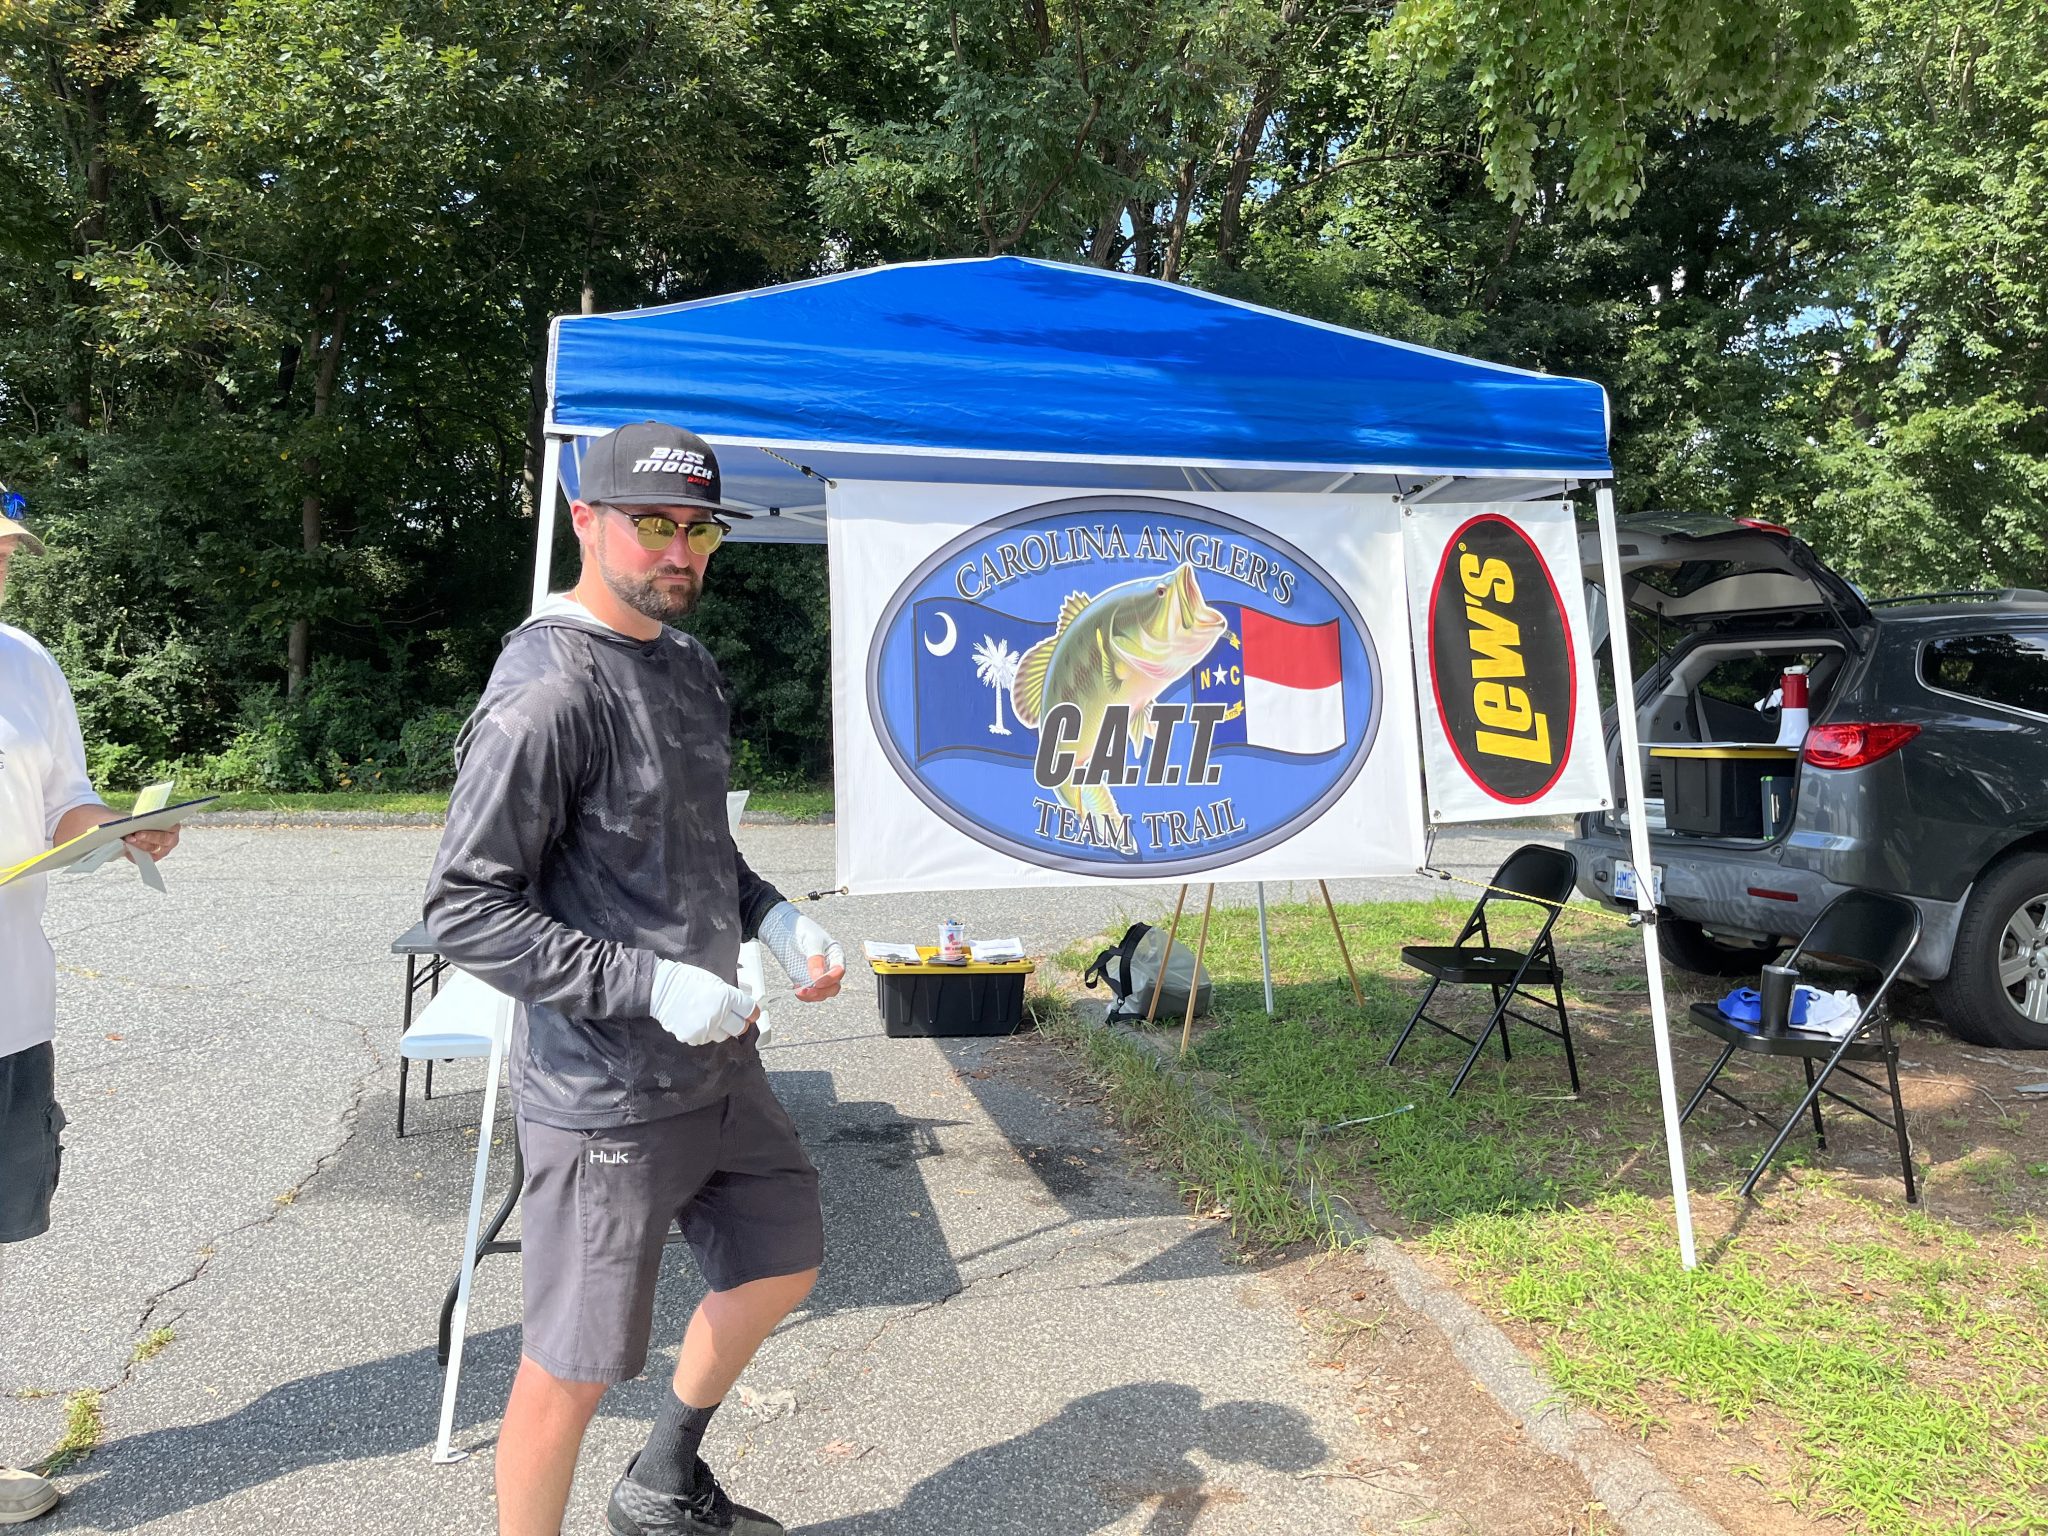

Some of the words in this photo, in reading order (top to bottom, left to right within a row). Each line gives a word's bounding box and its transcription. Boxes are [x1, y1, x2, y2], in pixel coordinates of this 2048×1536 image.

[632, 460, 713, 480] MOOCH
[650, 447, 704, 465] BASS
[955, 524, 1130, 599] CAROLINA
[1134, 526, 1295, 604] ANGLER'S
[1201, 668, 1211, 690] N
[1230, 665, 1241, 686] C
[1034, 702, 1227, 788] C.A.T.T.
[1034, 797, 1132, 848] TEAM
[1142, 798, 1245, 848] TRAIL
